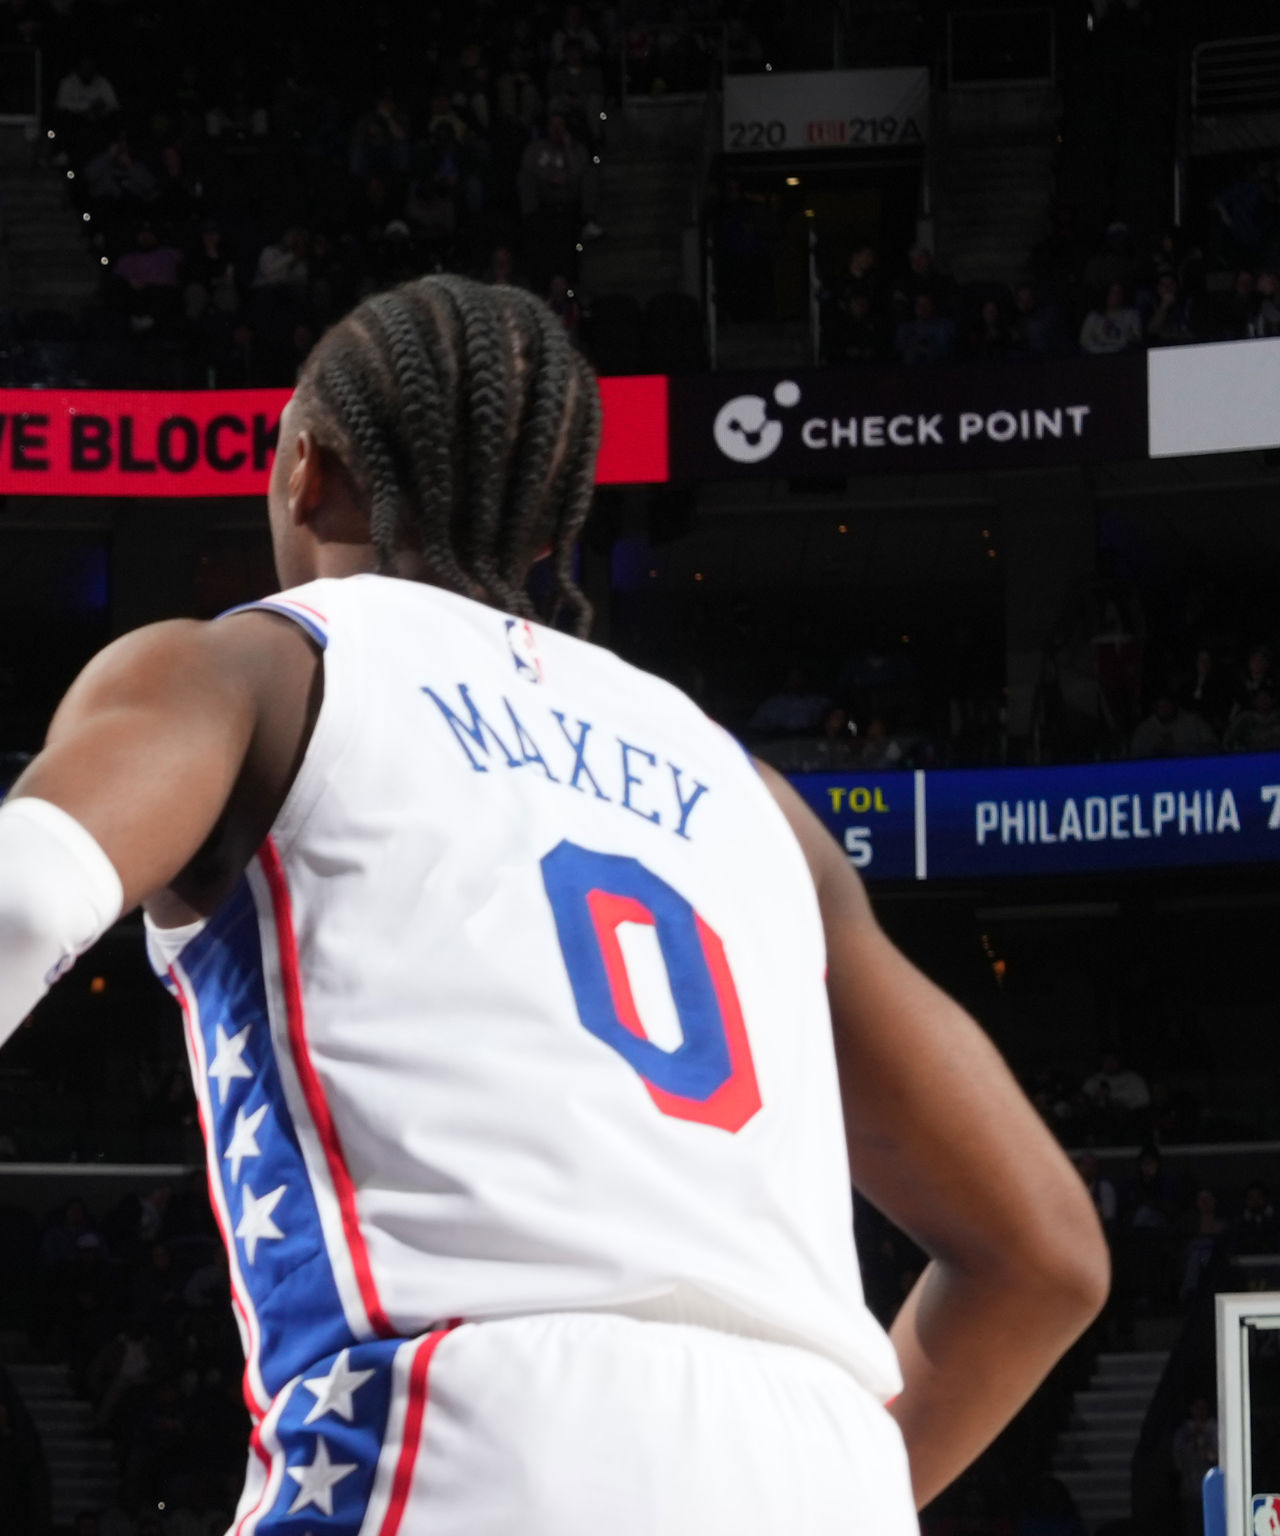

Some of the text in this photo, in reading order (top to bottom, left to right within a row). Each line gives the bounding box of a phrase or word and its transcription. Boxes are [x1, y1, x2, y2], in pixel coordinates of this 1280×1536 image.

[728, 120, 787, 149] 220
[848, 114, 923, 145] 219A
[70, 413, 282, 475] BLOCK
[801, 404, 1090, 450] CHECK POINT
[422, 683, 710, 841] MAXEY
[827, 787, 890, 813] TOL
[975, 785, 1280, 846] PHILADELPHIA 7
[844, 827, 873, 868] 5
[538, 838, 763, 1134] 0
